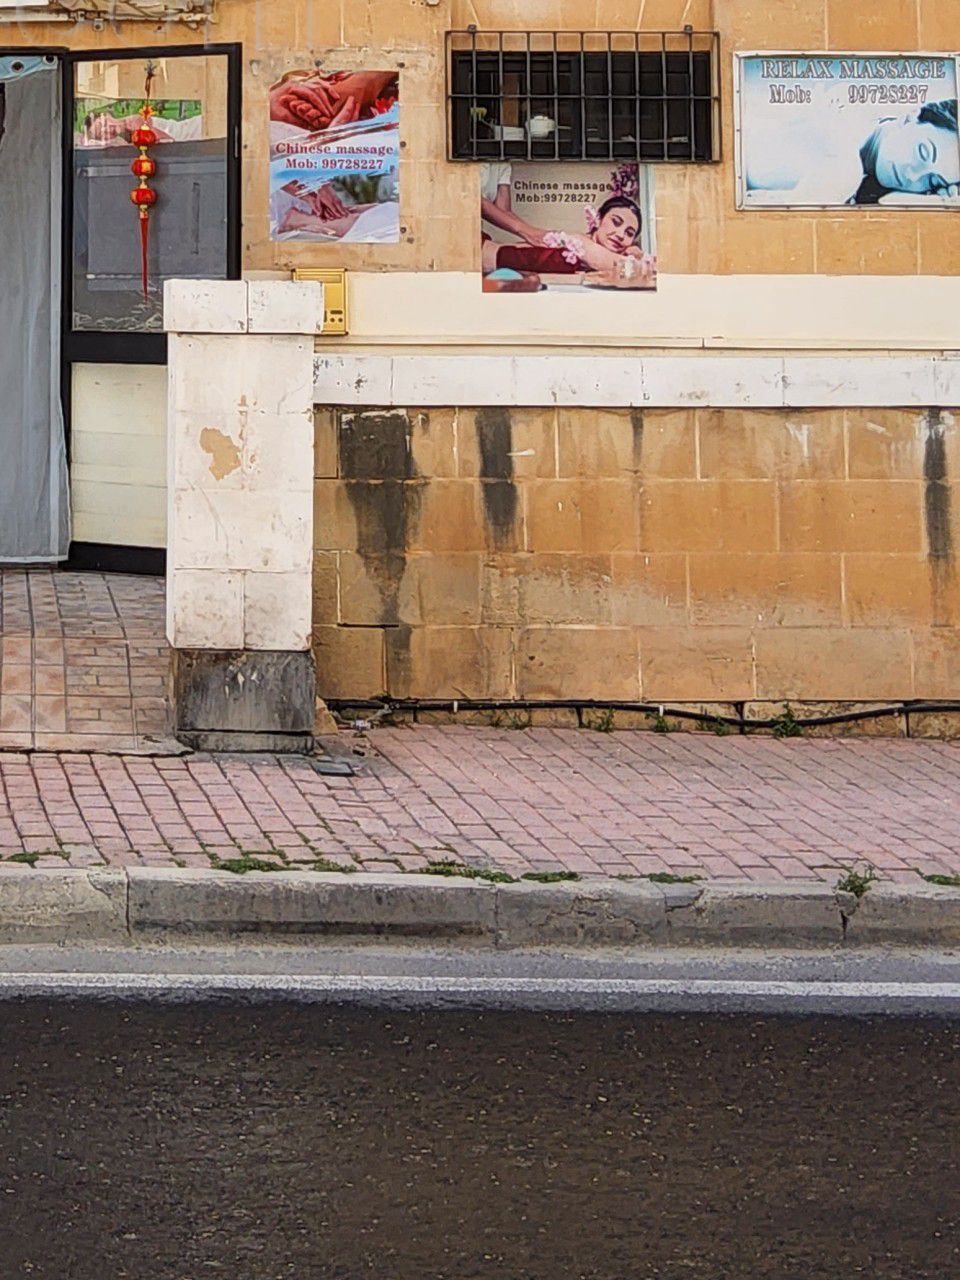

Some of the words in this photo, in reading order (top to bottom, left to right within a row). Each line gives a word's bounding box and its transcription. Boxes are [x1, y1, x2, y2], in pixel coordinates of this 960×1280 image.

[761, 59, 834, 79] RELAX
[839, 59, 946, 79] MASSAGE
[769, 84, 812, 104] Mob:
[848, 84, 929, 104] 99728227
[275, 142, 331, 155] Chinese
[336, 144, 394, 157] massage
[285, 158, 318, 169] Mob:
[322, 159, 384, 170] 99728227
[514, 181, 559, 191] Chinese
[563, 182, 614, 192] massage
[515, 193, 597, 203] Mob:99728227
